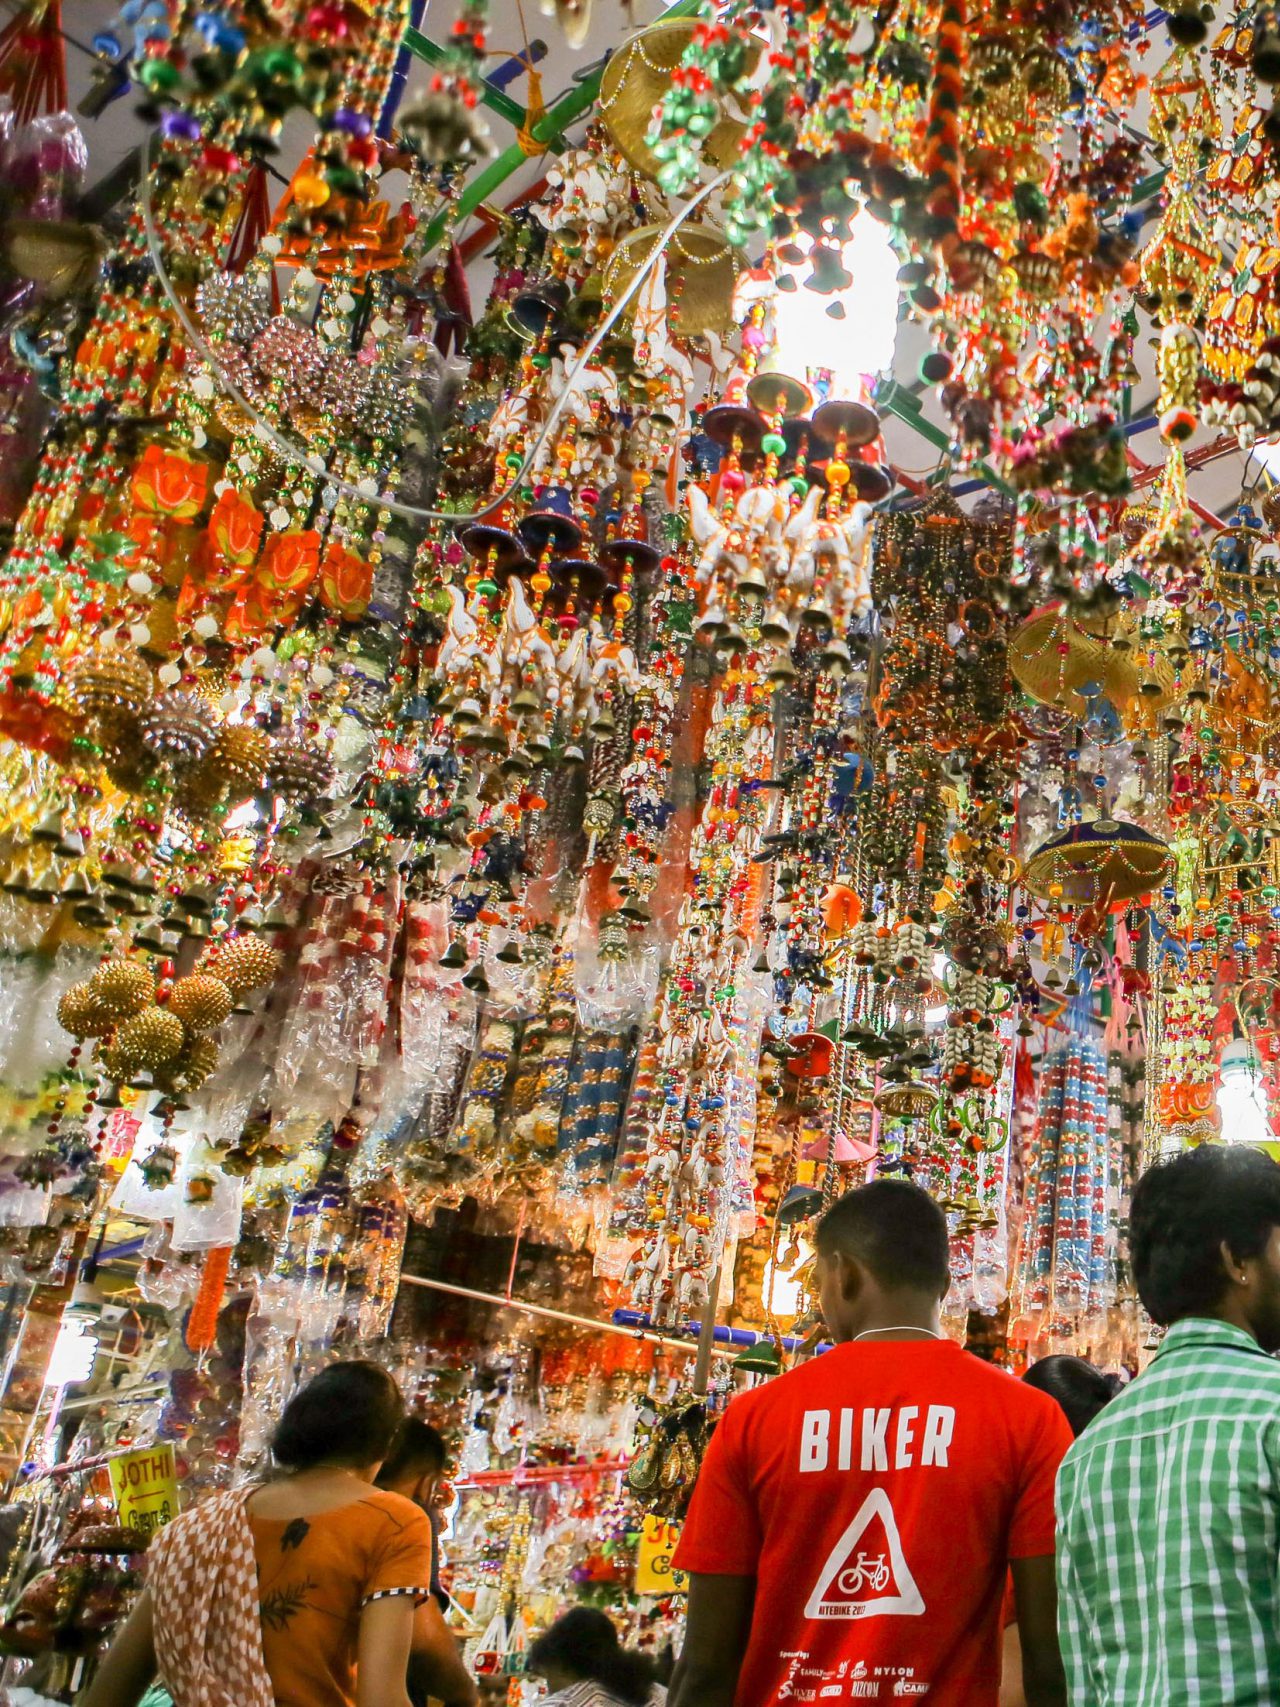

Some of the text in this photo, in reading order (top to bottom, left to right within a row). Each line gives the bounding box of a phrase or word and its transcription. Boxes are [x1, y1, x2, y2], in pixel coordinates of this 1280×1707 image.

[799, 1404, 956, 1473] BIKER
[119, 1453, 170, 1490] JOTHI
[873, 1667, 915, 1678] NYLON
